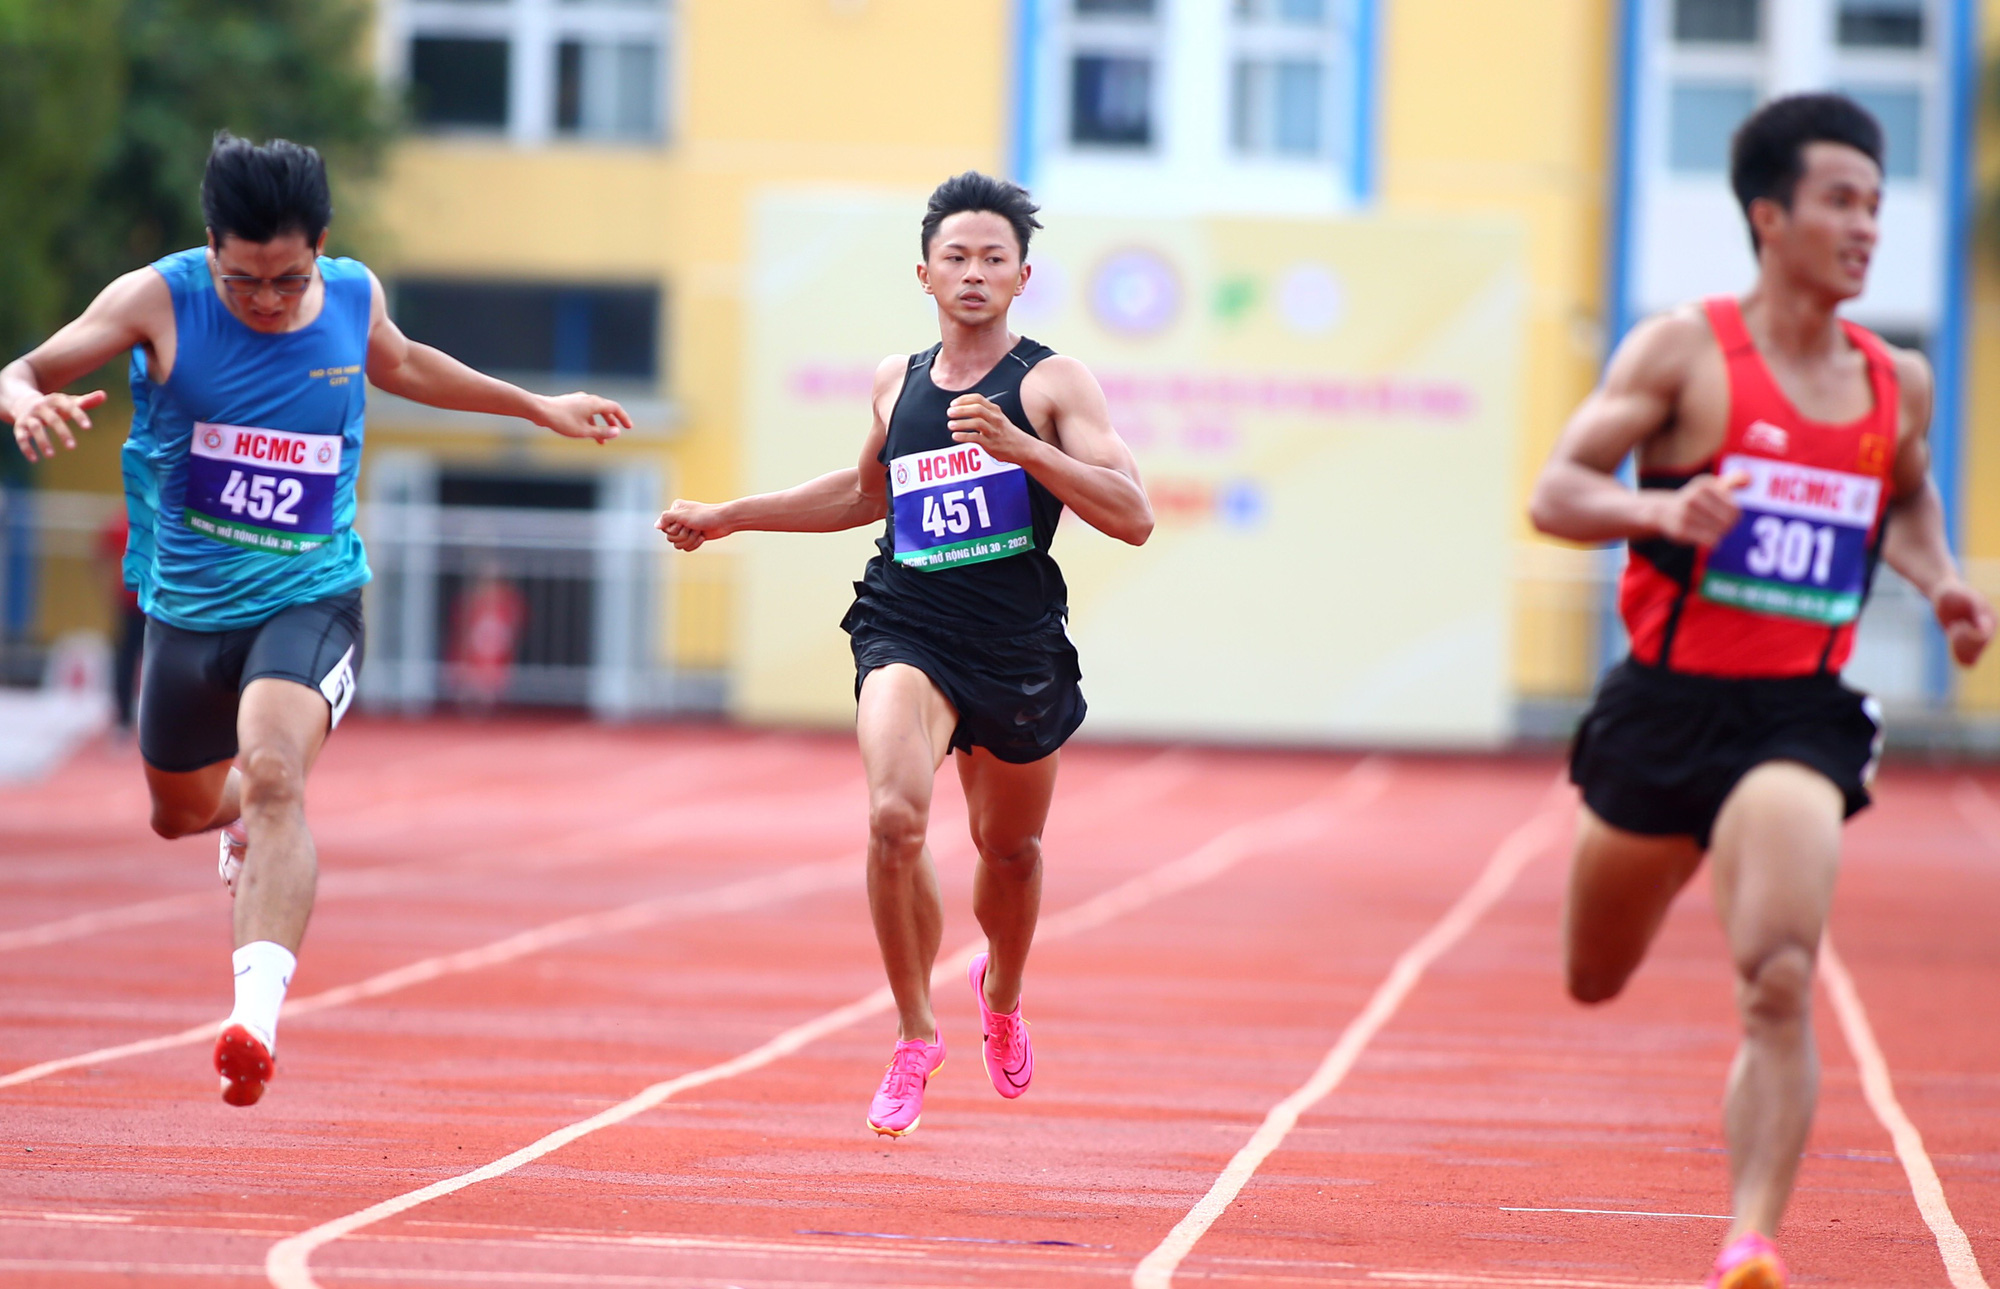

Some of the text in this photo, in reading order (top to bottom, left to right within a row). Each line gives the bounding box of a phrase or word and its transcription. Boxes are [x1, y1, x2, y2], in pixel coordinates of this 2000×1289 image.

[233, 432, 306, 464] HCMC
[917, 447, 982, 482] HCMC
[219, 469, 304, 525] 452
[921, 485, 992, 538] 451
[280, 539, 292, 550] 30
[945, 548, 970, 563] RỘNG
[989, 542, 1001, 553] 30
[1008, 536, 1027, 549] 2023
[1745, 514, 1836, 586] 301
